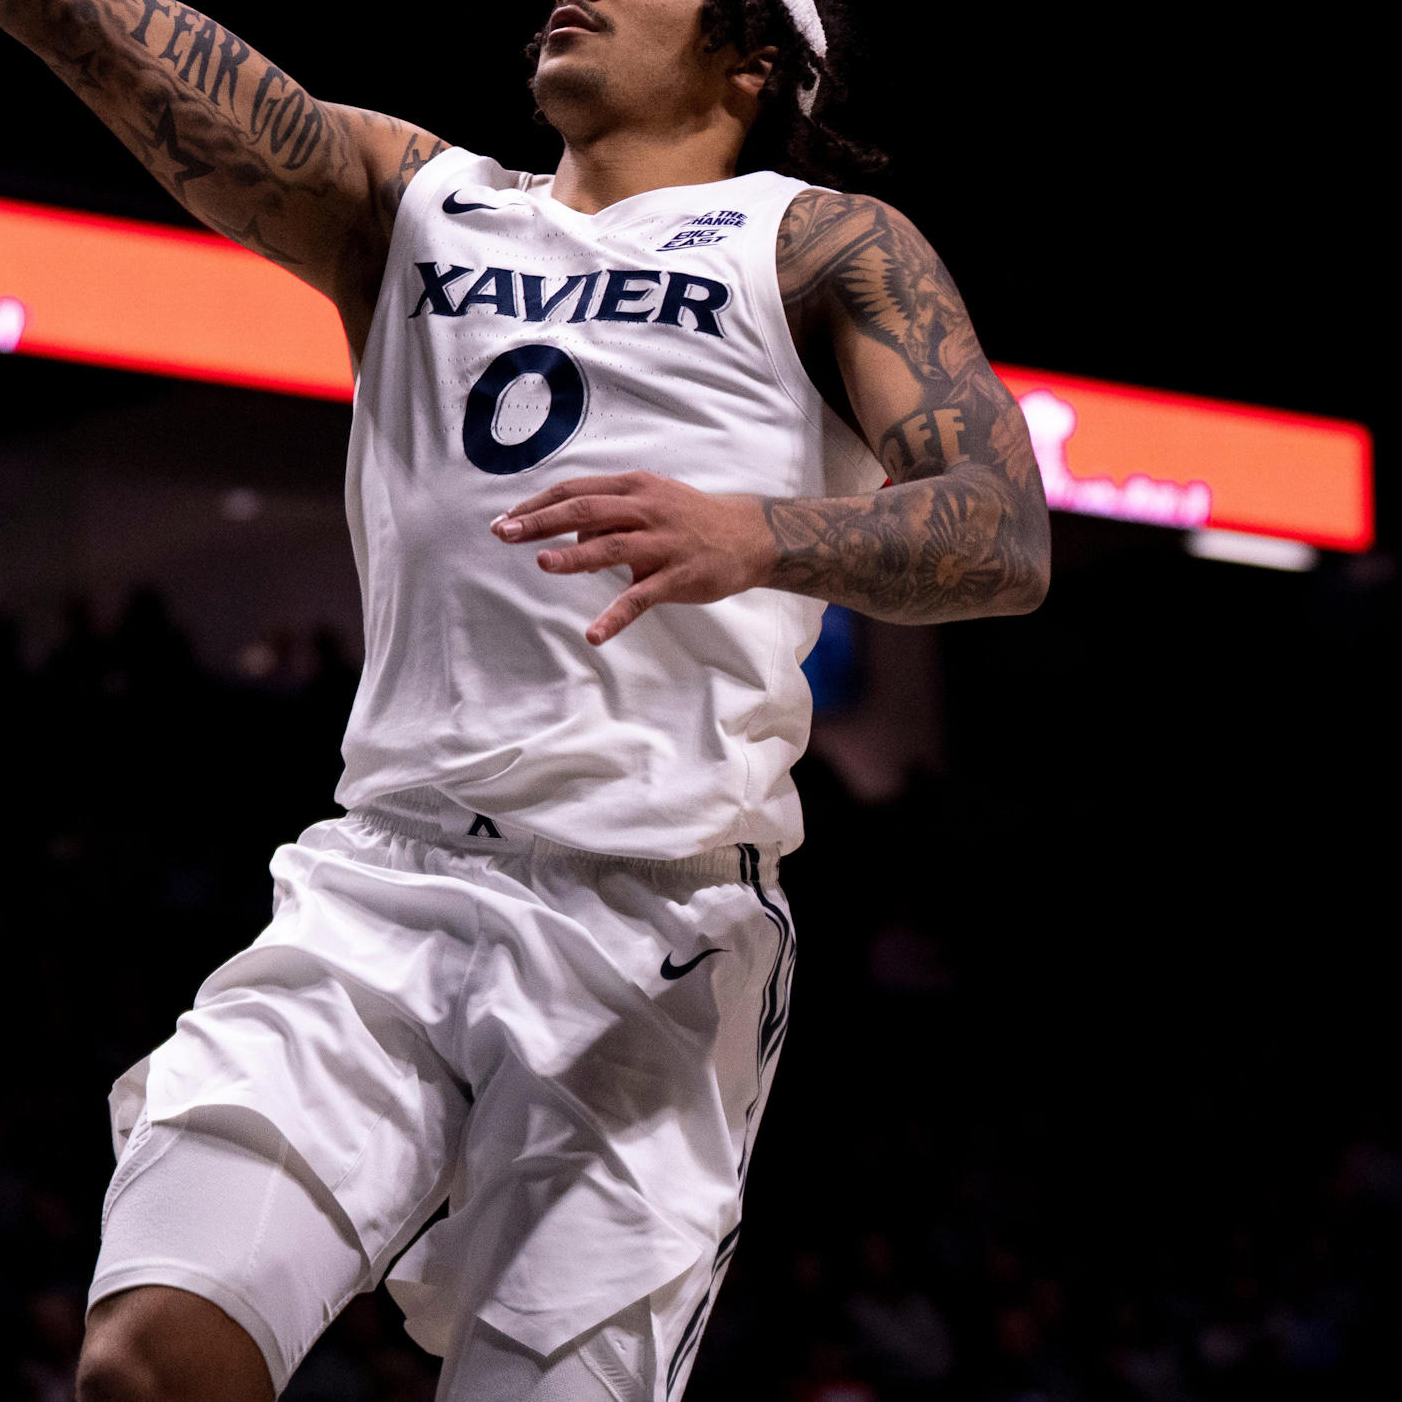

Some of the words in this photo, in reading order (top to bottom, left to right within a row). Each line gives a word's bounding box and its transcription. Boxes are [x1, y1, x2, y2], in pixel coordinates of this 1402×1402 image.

[249, 65, 323, 170] GOD
[661, 236, 728, 248] EAST
[672, 229, 720, 240] BIG
[408, 261, 731, 339] XAVIER
[462, 343, 590, 475] 0
